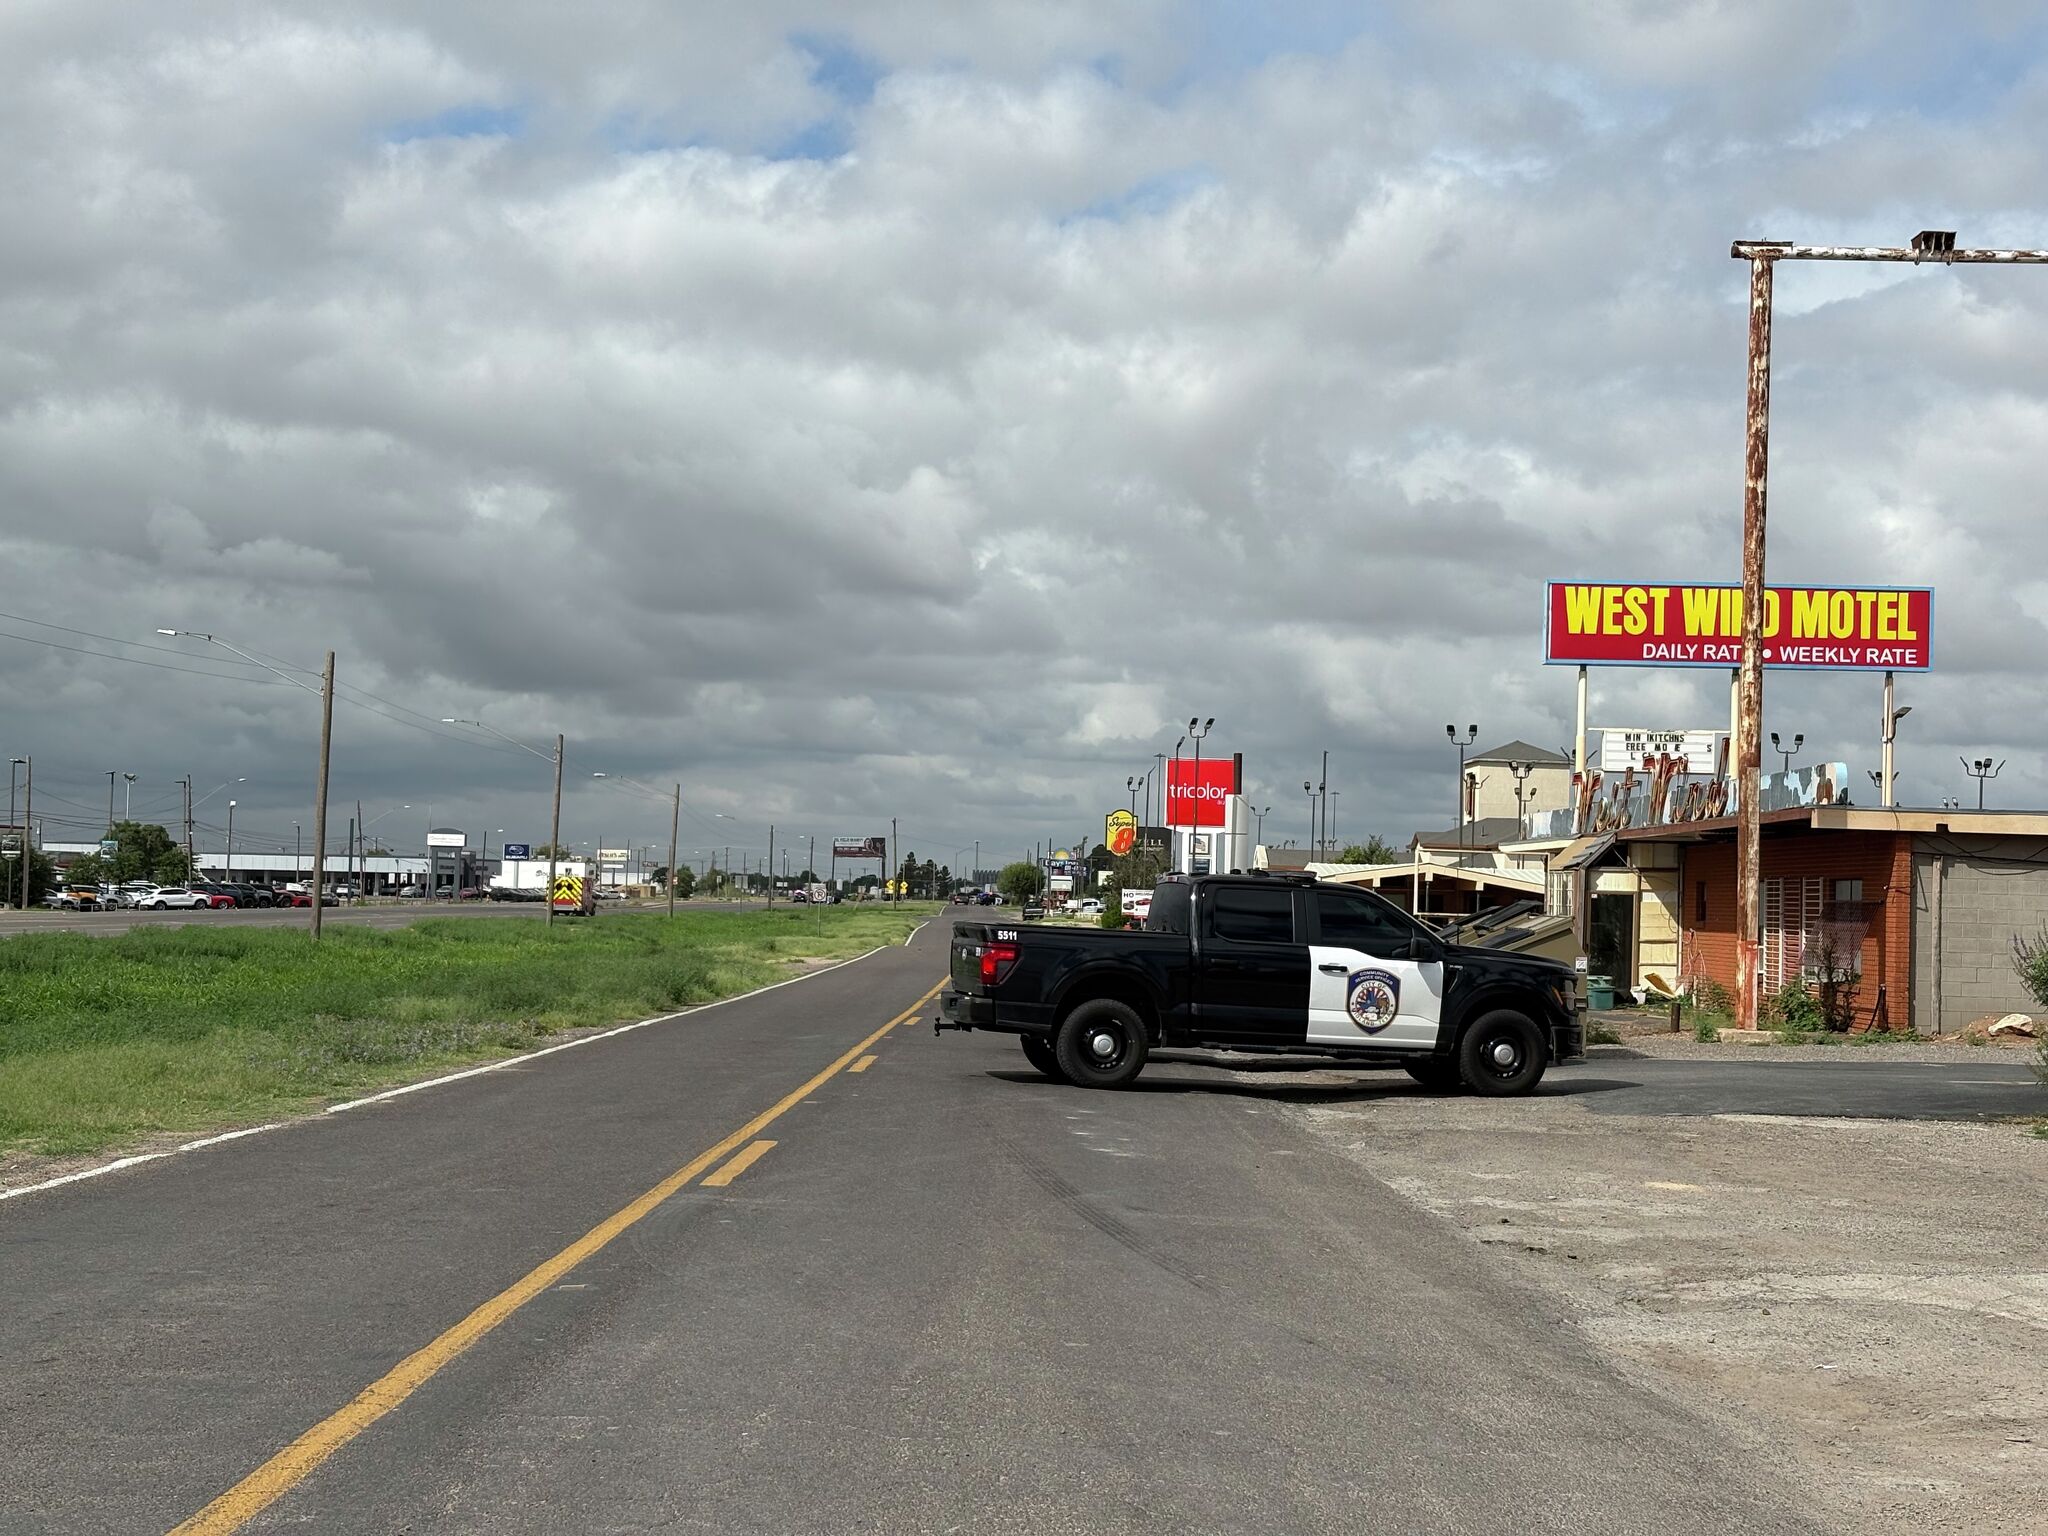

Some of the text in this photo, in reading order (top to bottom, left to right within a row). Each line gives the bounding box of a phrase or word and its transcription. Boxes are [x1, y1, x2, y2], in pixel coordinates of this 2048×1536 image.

[1564, 586, 1670, 635] WEST
[1792, 590, 1918, 642] MOTEL
[1642, 643, 1918, 664] DAILY RAT WEEKLY RATE
[1625, 742, 1647, 752] FREE
[1169, 782, 1228, 801] tricolor
[1108, 816, 1136, 832] Super
[1111, 827, 1136, 854] 8
[997, 930, 1018, 941] 5511
[1354, 975, 1394, 985] SERVICE OFFICER
[1359, 970, 1390, 978] COMMUNITY
[1361, 981, 1376, 989] CITY
